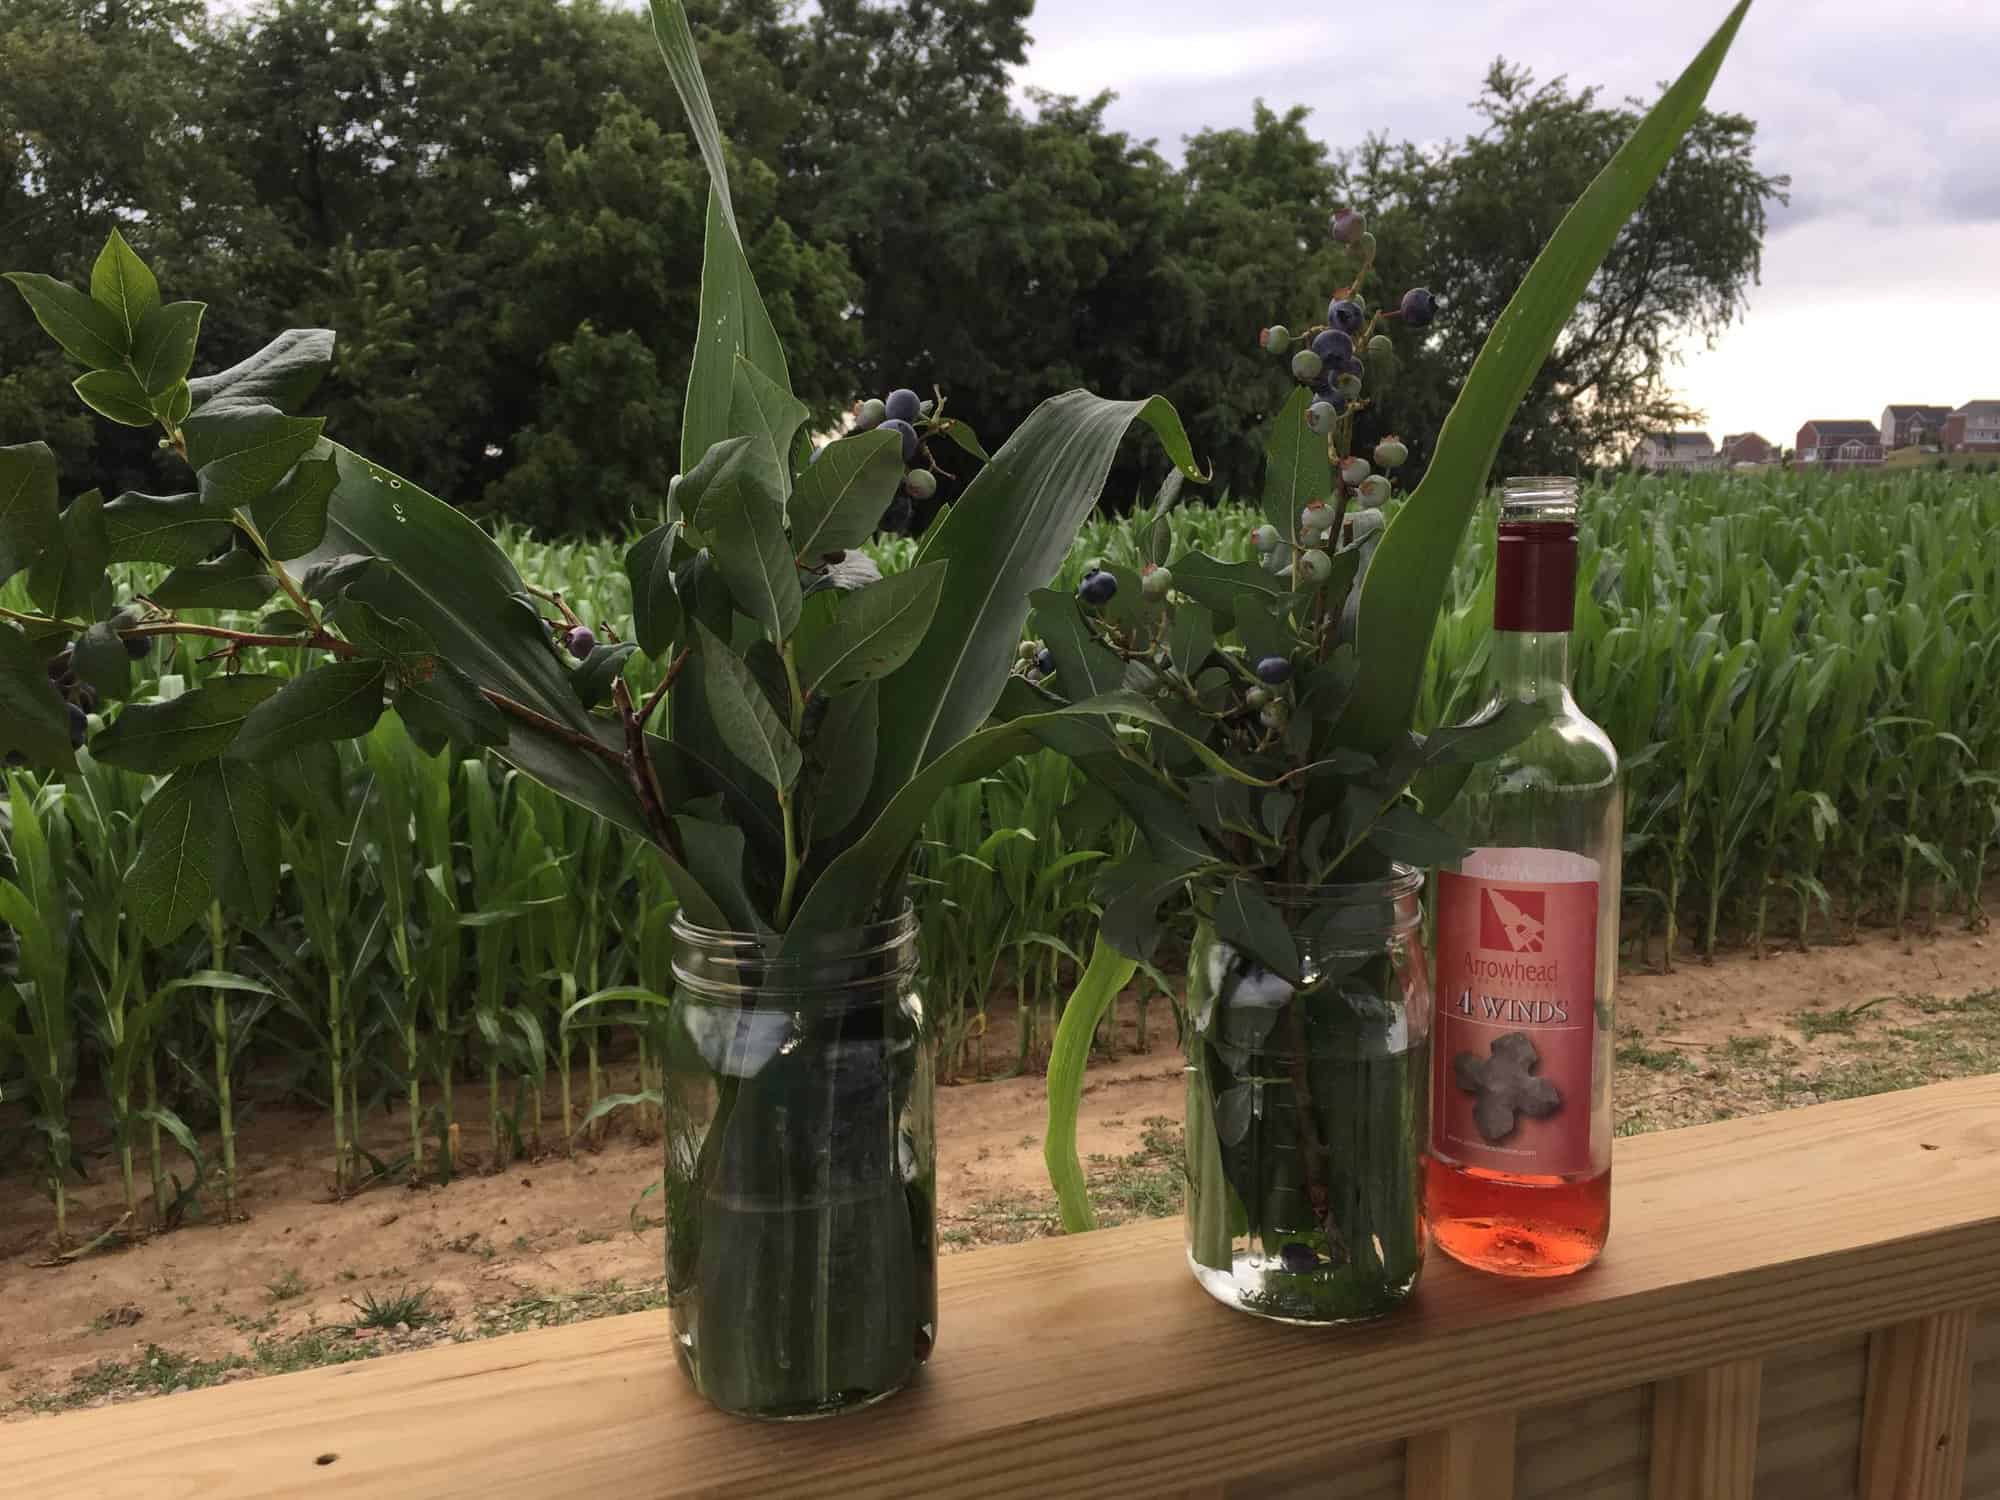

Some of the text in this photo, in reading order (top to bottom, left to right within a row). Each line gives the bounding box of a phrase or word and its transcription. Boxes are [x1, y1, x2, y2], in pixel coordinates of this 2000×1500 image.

[1464, 951, 1558, 982] Arrowhead
[1457, 986, 1569, 1024] 4 WINDS
